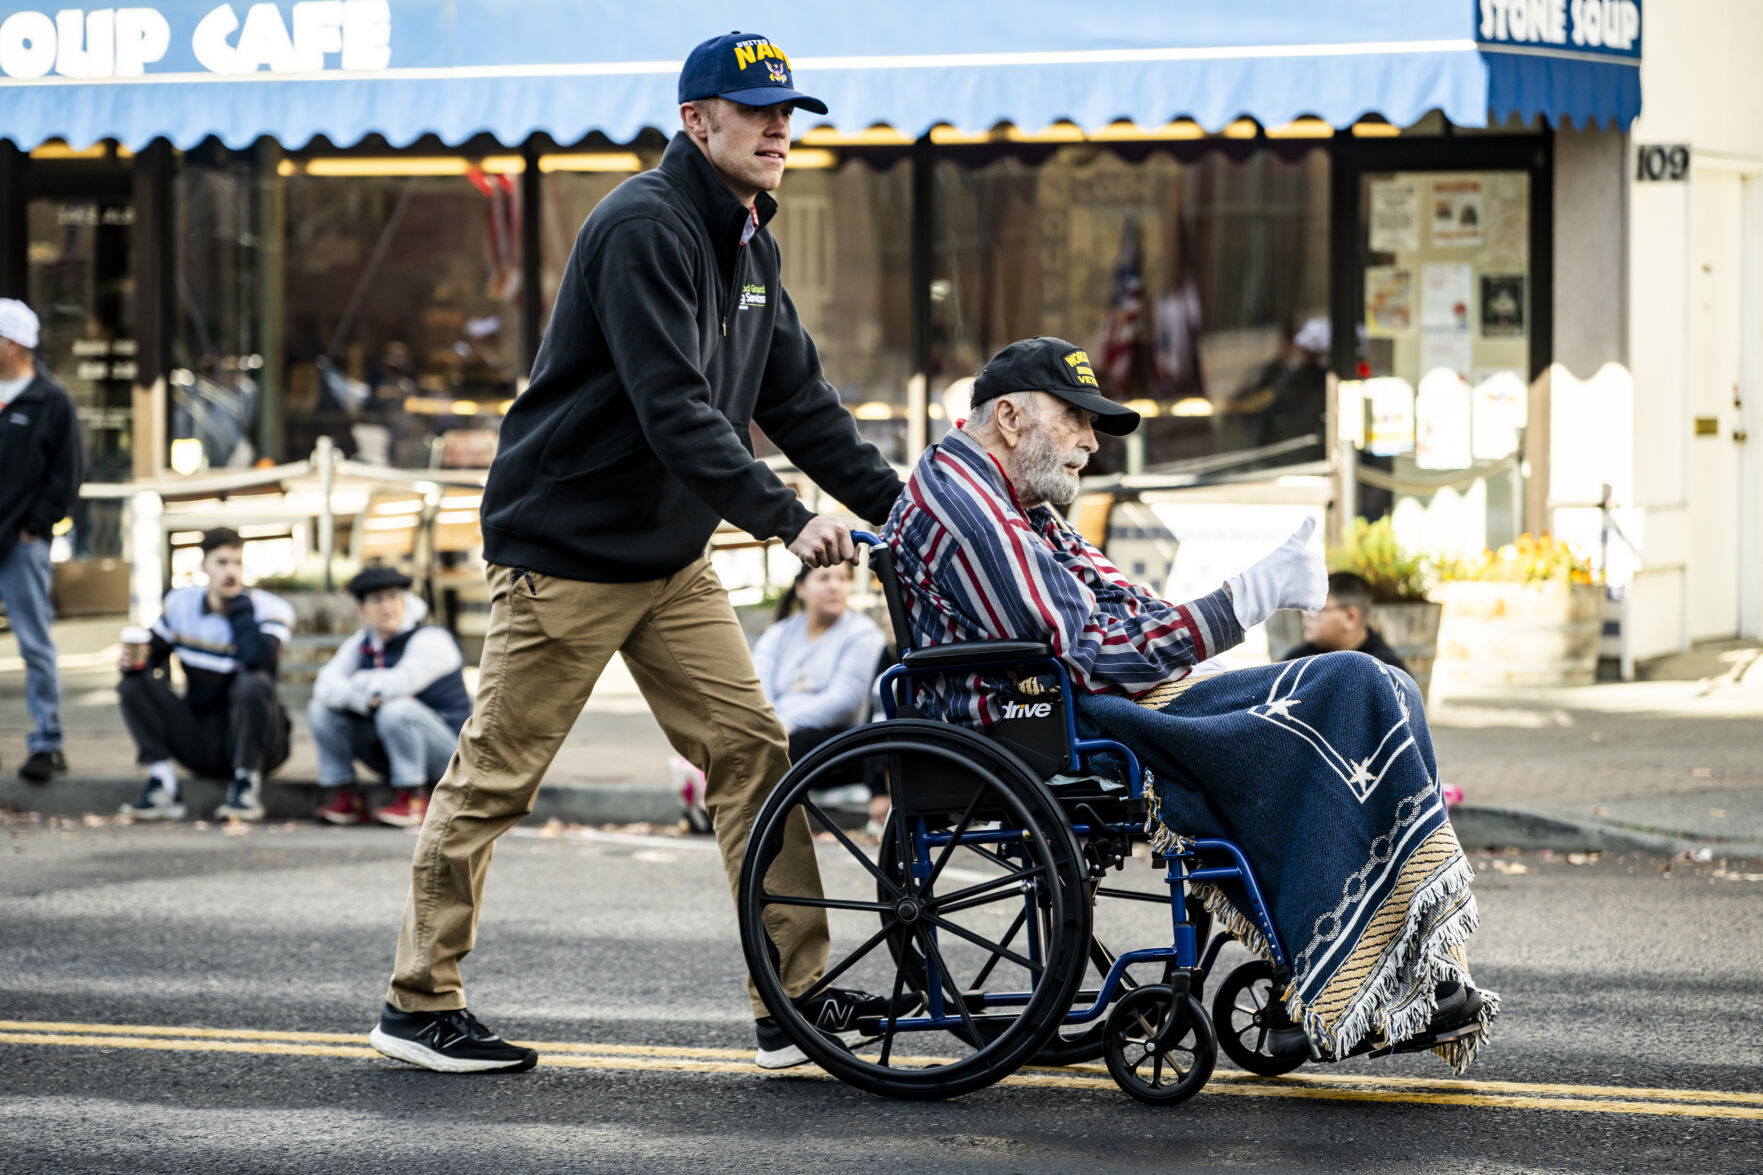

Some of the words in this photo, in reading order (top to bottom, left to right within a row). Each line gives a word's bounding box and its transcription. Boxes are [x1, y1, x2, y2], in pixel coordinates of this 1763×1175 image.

[192, 0, 391, 75] CAFE
[1479, 0, 1567, 44] STONE
[1571, 0, 1640, 50] SOUP
[736, 38, 768, 48] UNITED
[734, 44, 792, 72] NAV
[1637, 145, 1689, 180] 109
[1064, 351, 1089, 368] WORL
[1001, 700, 1052, 719] drive
